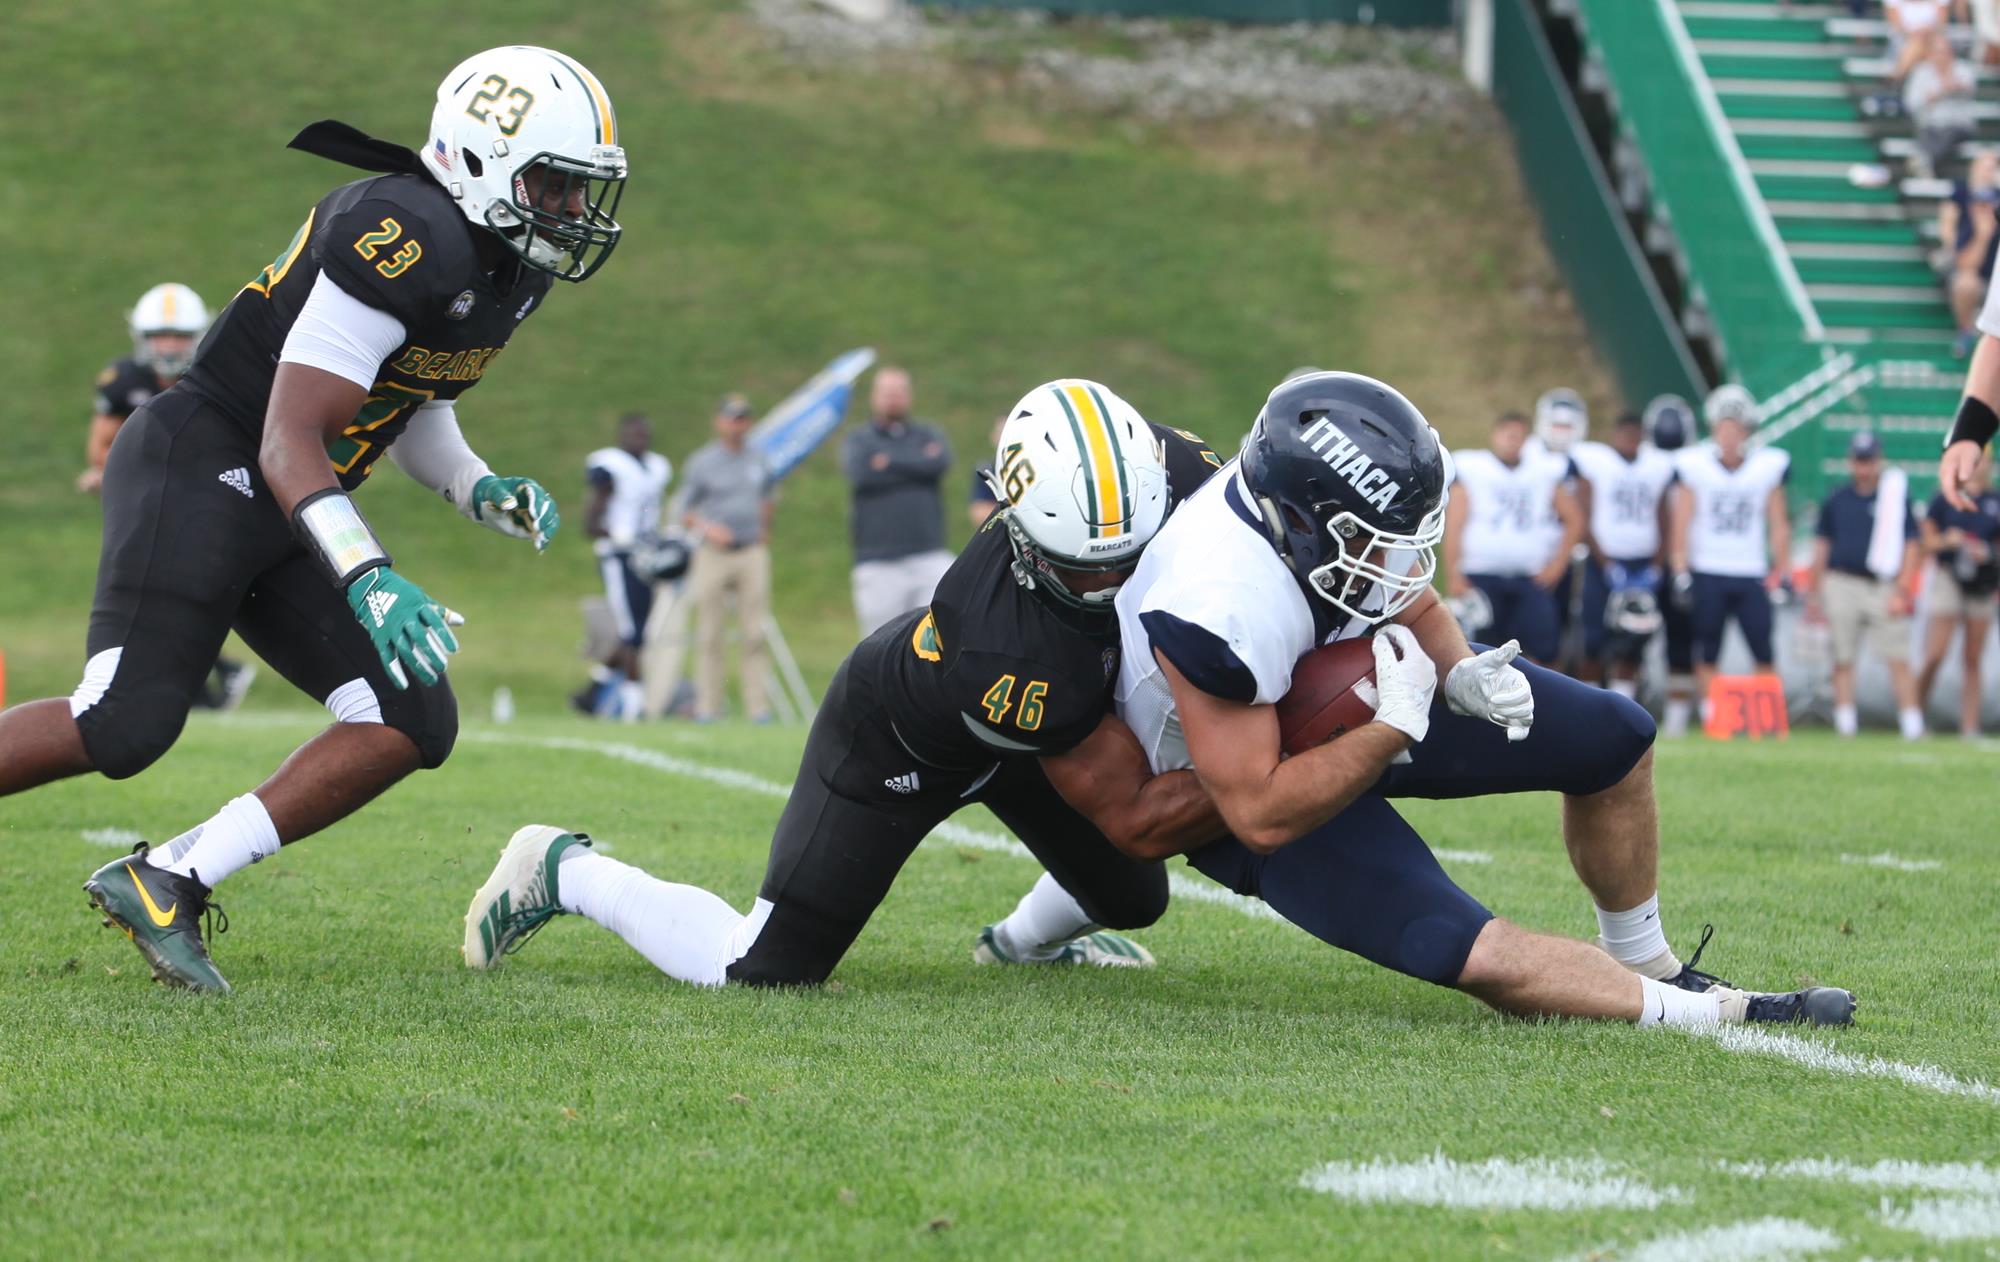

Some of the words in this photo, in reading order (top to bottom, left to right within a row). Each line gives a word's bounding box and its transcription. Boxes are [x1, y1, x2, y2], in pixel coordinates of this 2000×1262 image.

[466, 73, 536, 137] 23
[353, 217, 423, 279] 23
[218, 473, 254, 498] adidas
[1299, 416, 1401, 514] ITHACA
[1090, 539, 1132, 552] BEARCATS
[981, 674, 1048, 730] 46
